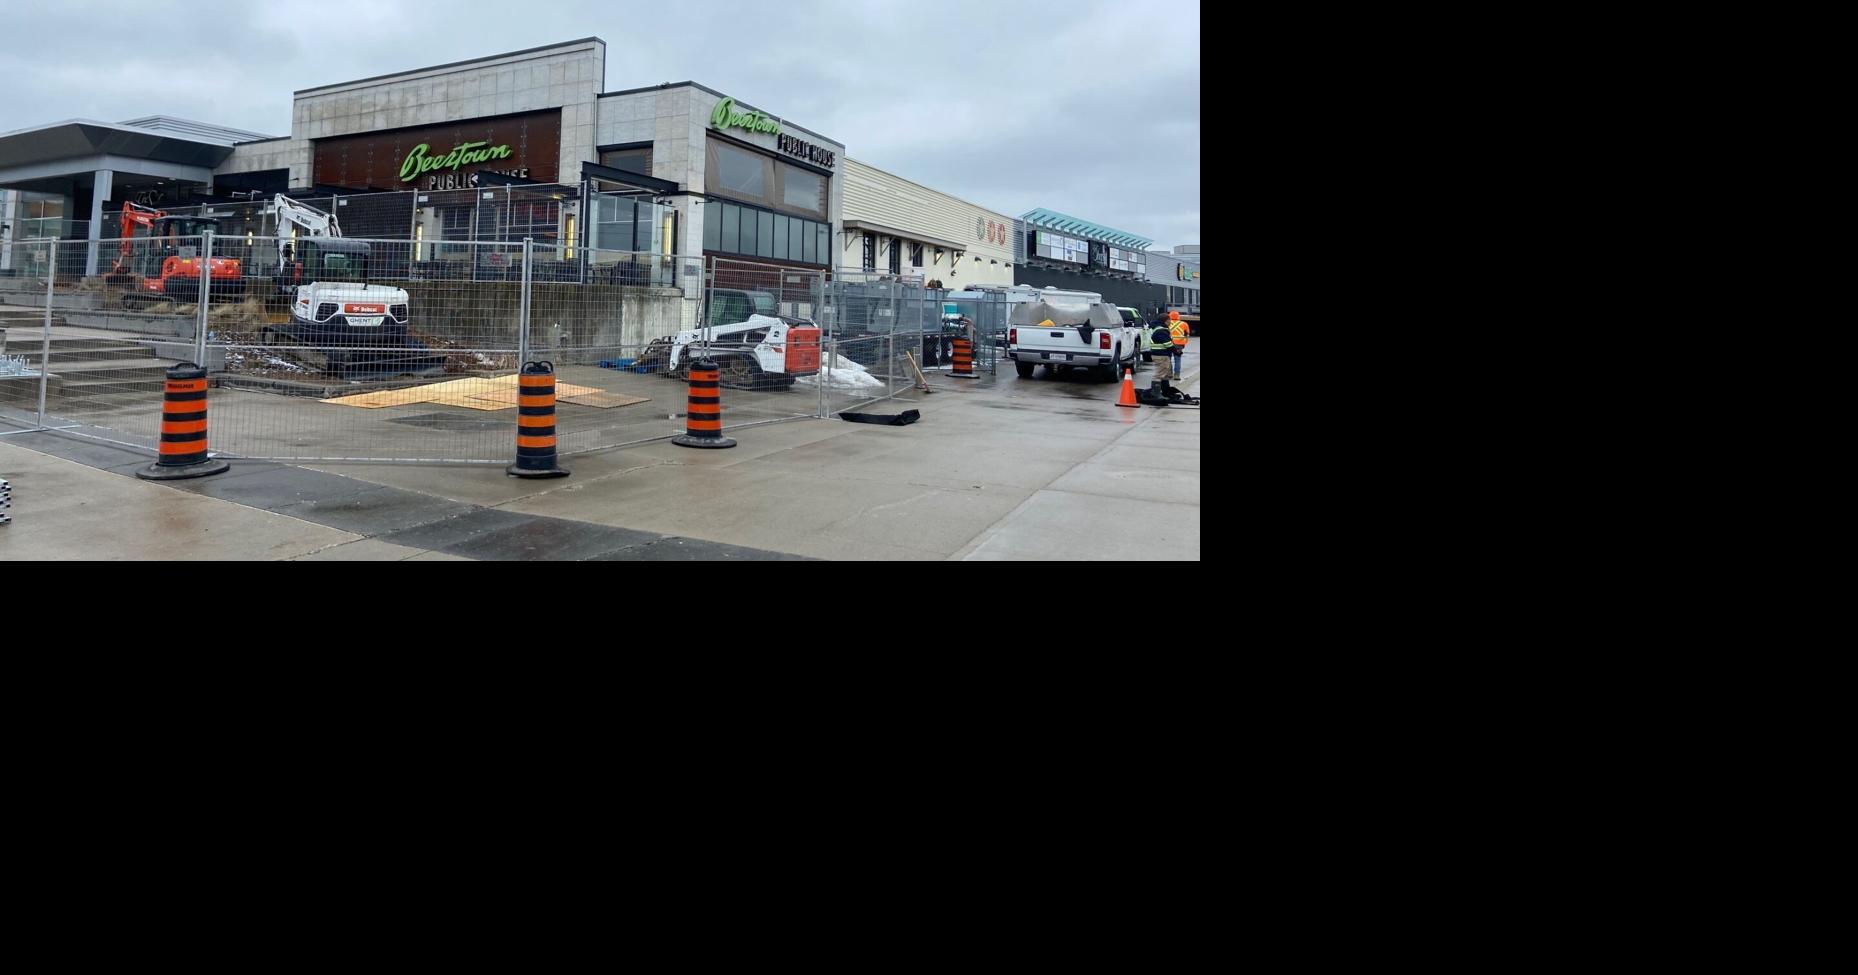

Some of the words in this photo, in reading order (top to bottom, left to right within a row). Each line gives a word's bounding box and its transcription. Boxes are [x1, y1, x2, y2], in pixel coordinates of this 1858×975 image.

[399, 142, 513, 182] Beertown
[778, 133, 809, 158] PUBLIC
[809, 145, 835, 168] HOUSE
